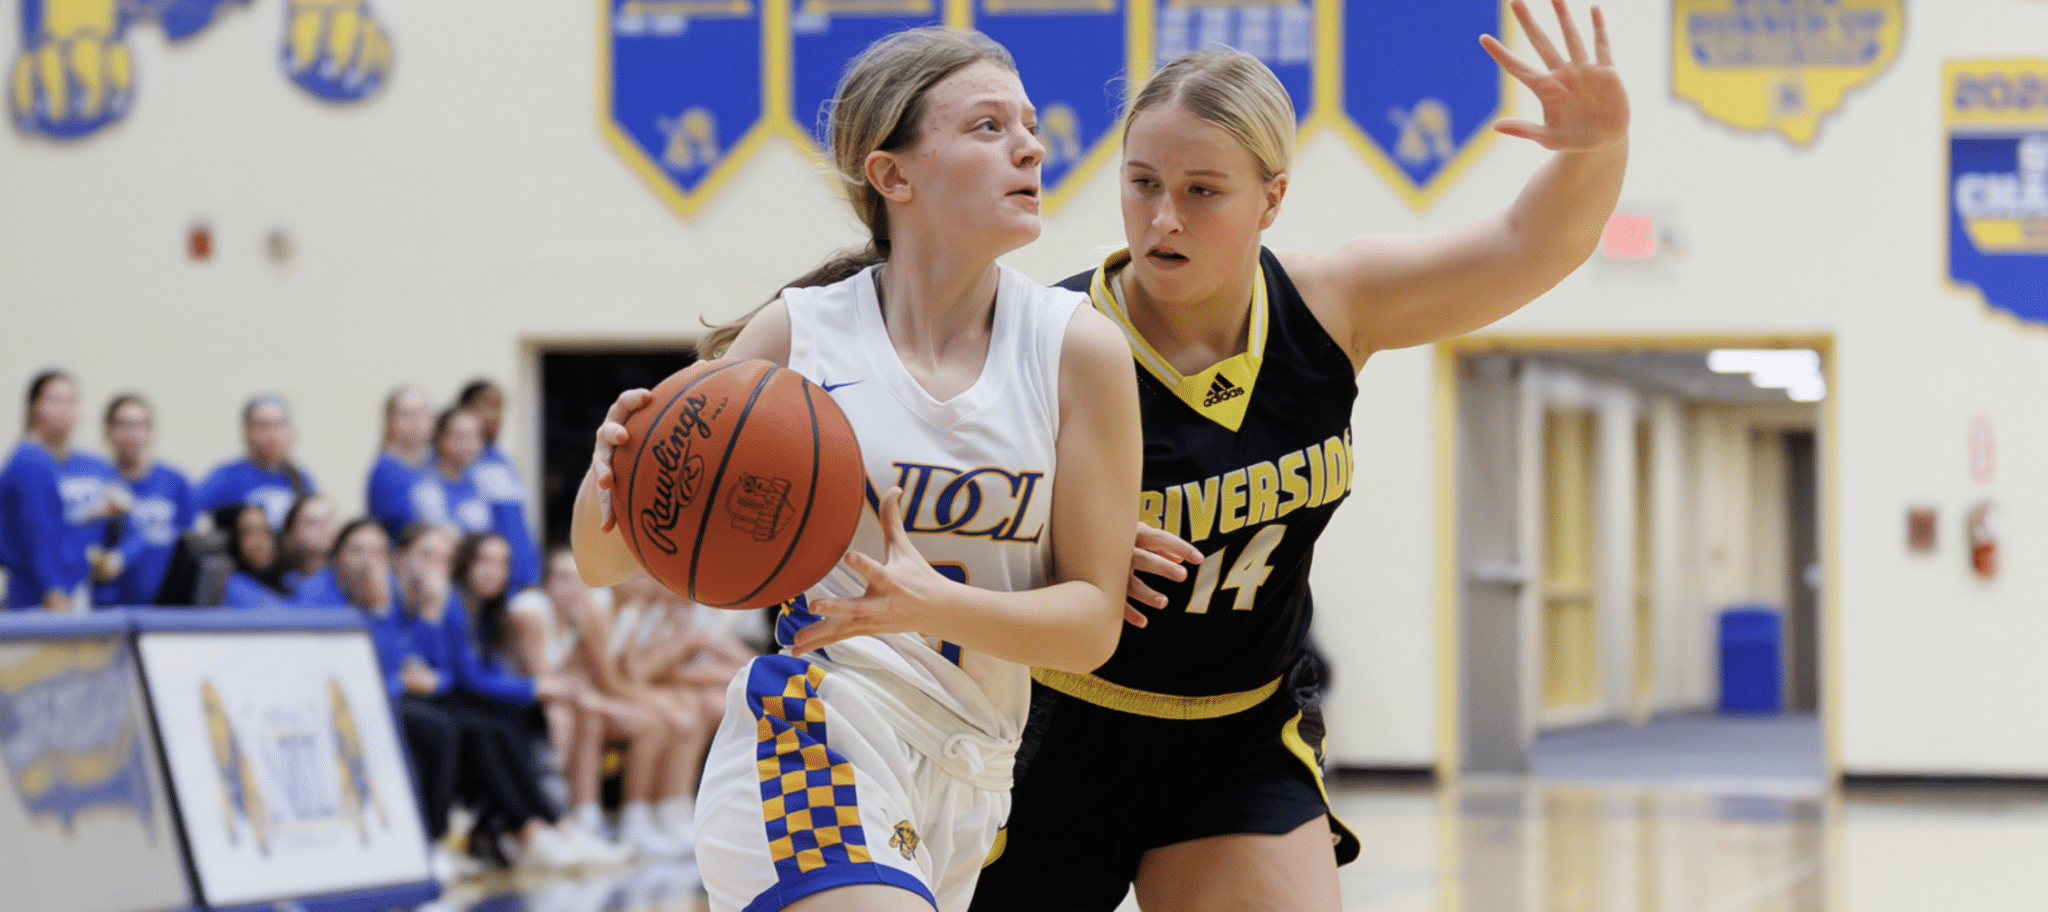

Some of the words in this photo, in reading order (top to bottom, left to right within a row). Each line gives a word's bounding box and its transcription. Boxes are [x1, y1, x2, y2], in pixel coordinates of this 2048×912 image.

[1203, 386, 1245, 408] adidas
[641, 393, 711, 555] Rawlings
[1184, 524, 1288, 614] 14
